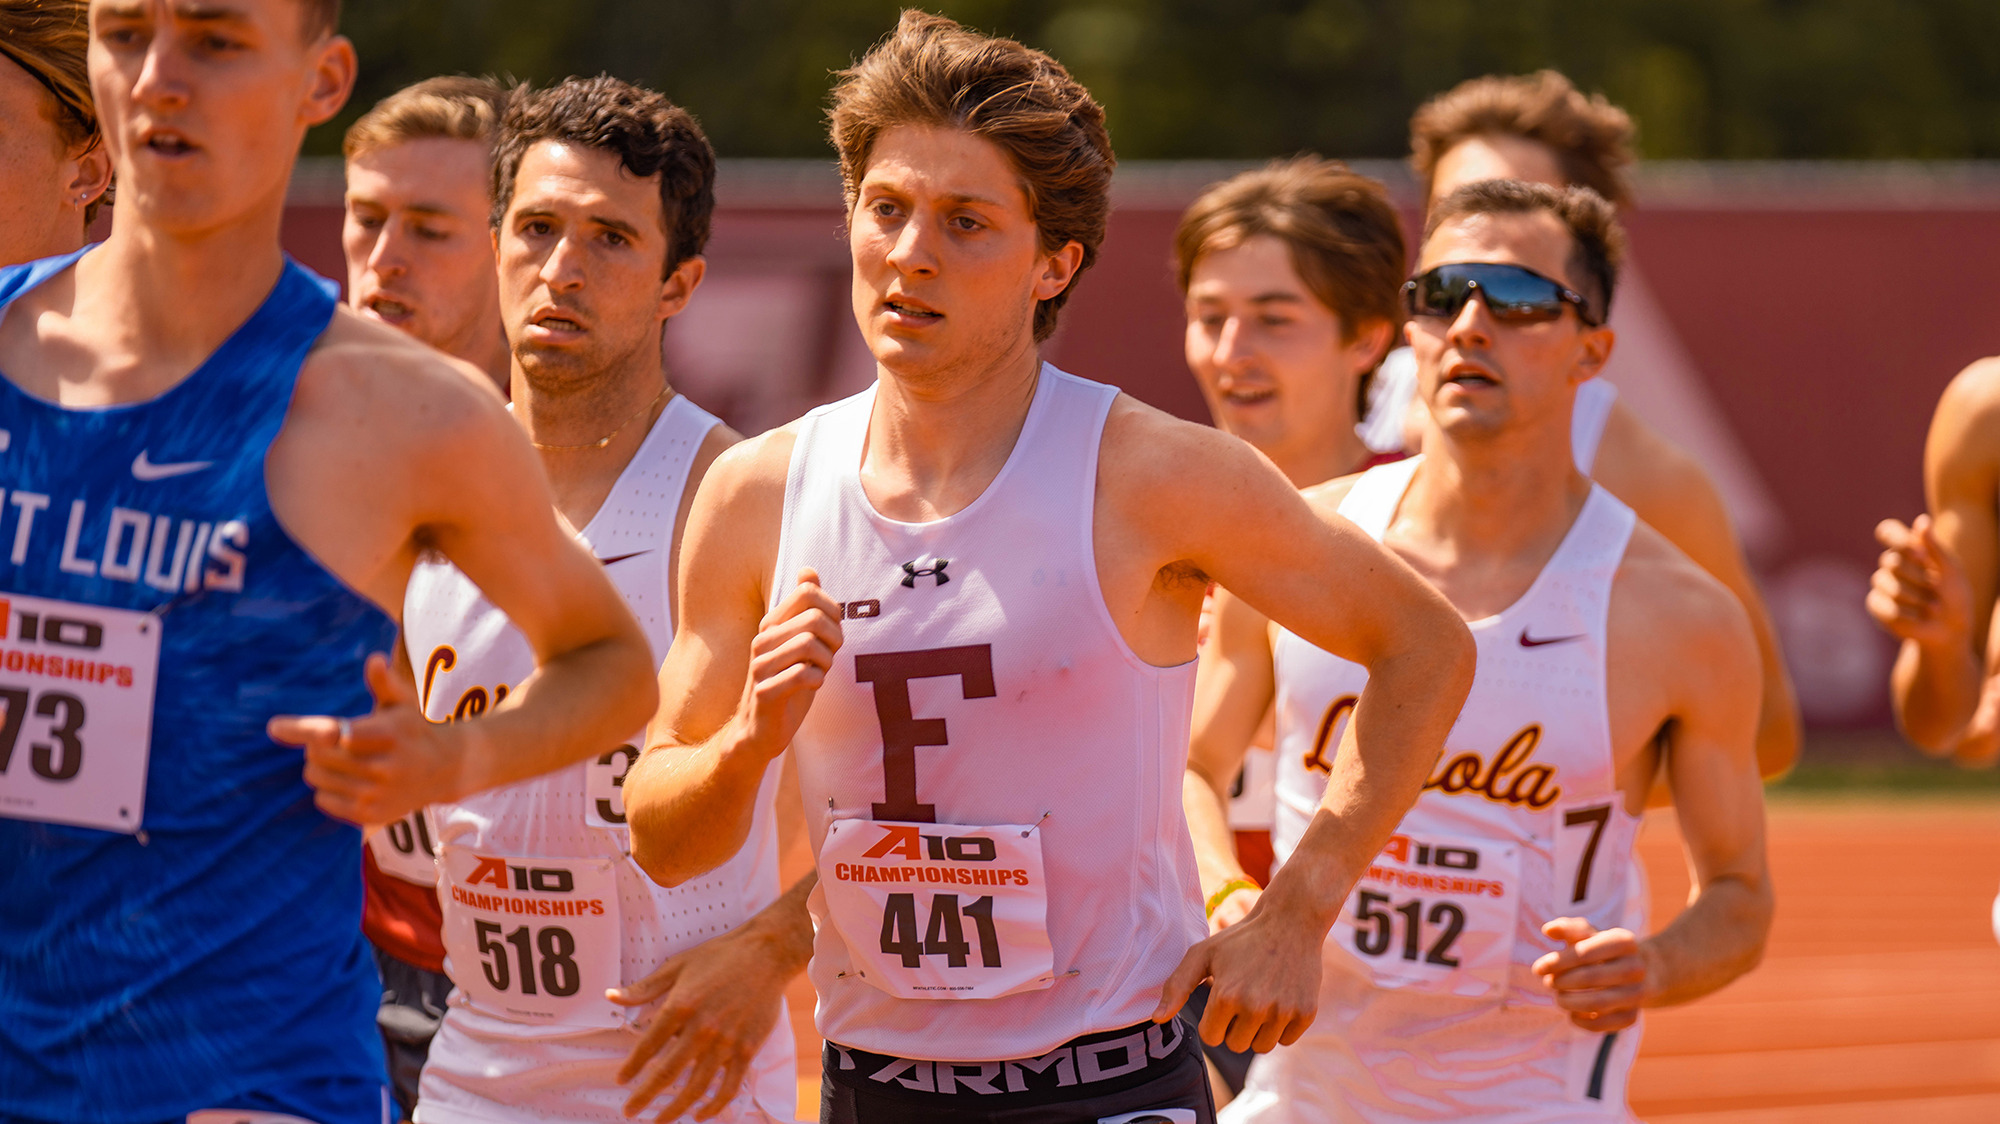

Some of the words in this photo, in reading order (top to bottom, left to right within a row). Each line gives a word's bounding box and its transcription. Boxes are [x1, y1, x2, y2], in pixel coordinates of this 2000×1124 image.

[59, 499, 250, 594] LOUIS
[0, 599, 104, 651] 10
[855, 643, 997, 824] F
[1304, 690, 1561, 812] Lola
[595, 743, 641, 824] 3
[464, 854, 574, 893] A10
[835, 862, 1029, 886] CHAMPIONSHIPS
[861, 824, 997, 862] A10
[1563, 804, 1613, 904] 7
[451, 884, 605, 916] CHAMPIONSHIPS
[1366, 865, 1504, 898] MPIONSHIPS
[474, 917, 581, 997] 518
[879, 893, 1002, 968] 441
[1354, 890, 1467, 968] 512
